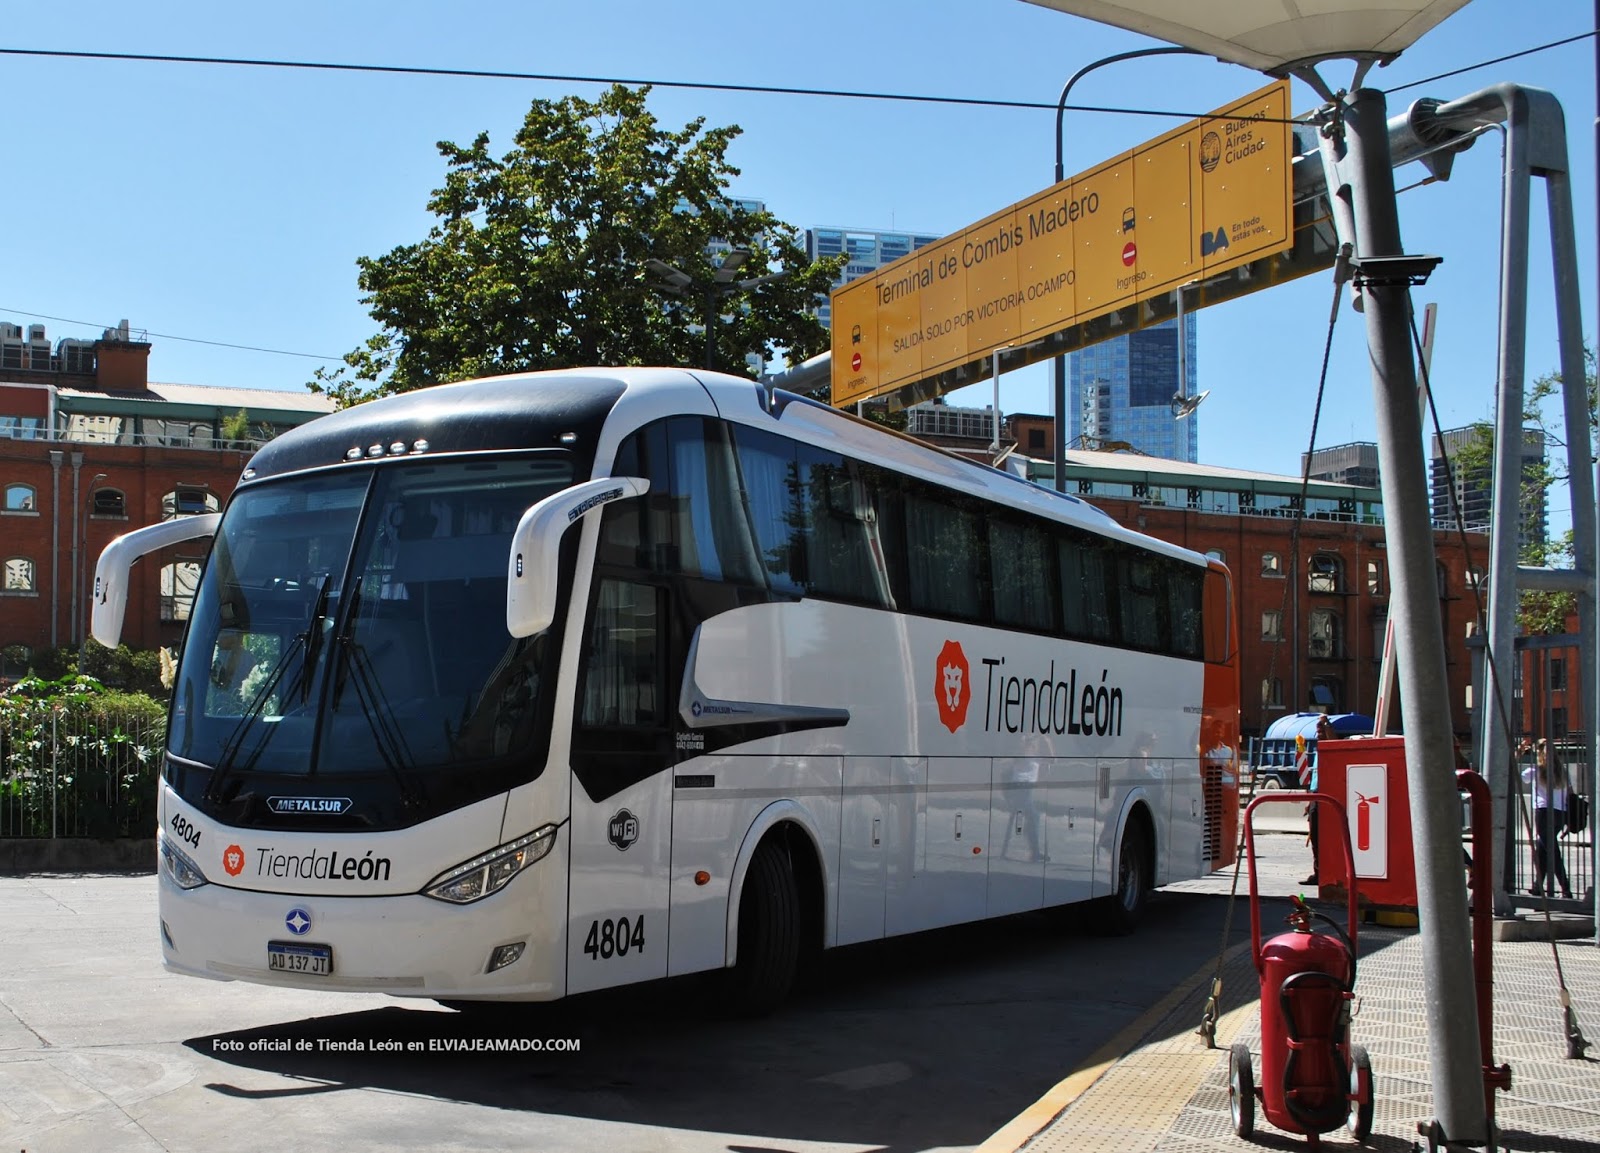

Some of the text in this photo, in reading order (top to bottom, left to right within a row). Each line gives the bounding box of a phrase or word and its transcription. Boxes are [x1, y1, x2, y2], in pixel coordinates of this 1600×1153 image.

[1225, 110, 1266, 135] Buenos
[1225, 130, 1253, 150] Aires
[1225, 138, 1265, 164] Ciudad
[1232, 216, 1261, 232] En todo
[875, 191, 1099, 307] Terminal de Combis Madero
[1116, 270, 1147, 290] Ingreso
[893, 269, 1076, 353] SALIDA SOLO POR VICTORIA OCAMPO
[982, 656, 1123, 737] TiendaLeón
[275, 799, 342, 812] METALSUR
[171, 812, 202, 850] 4804
[611, 819, 636, 836] WiFi
[256, 847, 391, 881] TiendaLeón
[584, 914, 645, 960] 4804
[271, 953, 327, 974] AD 137 JT
